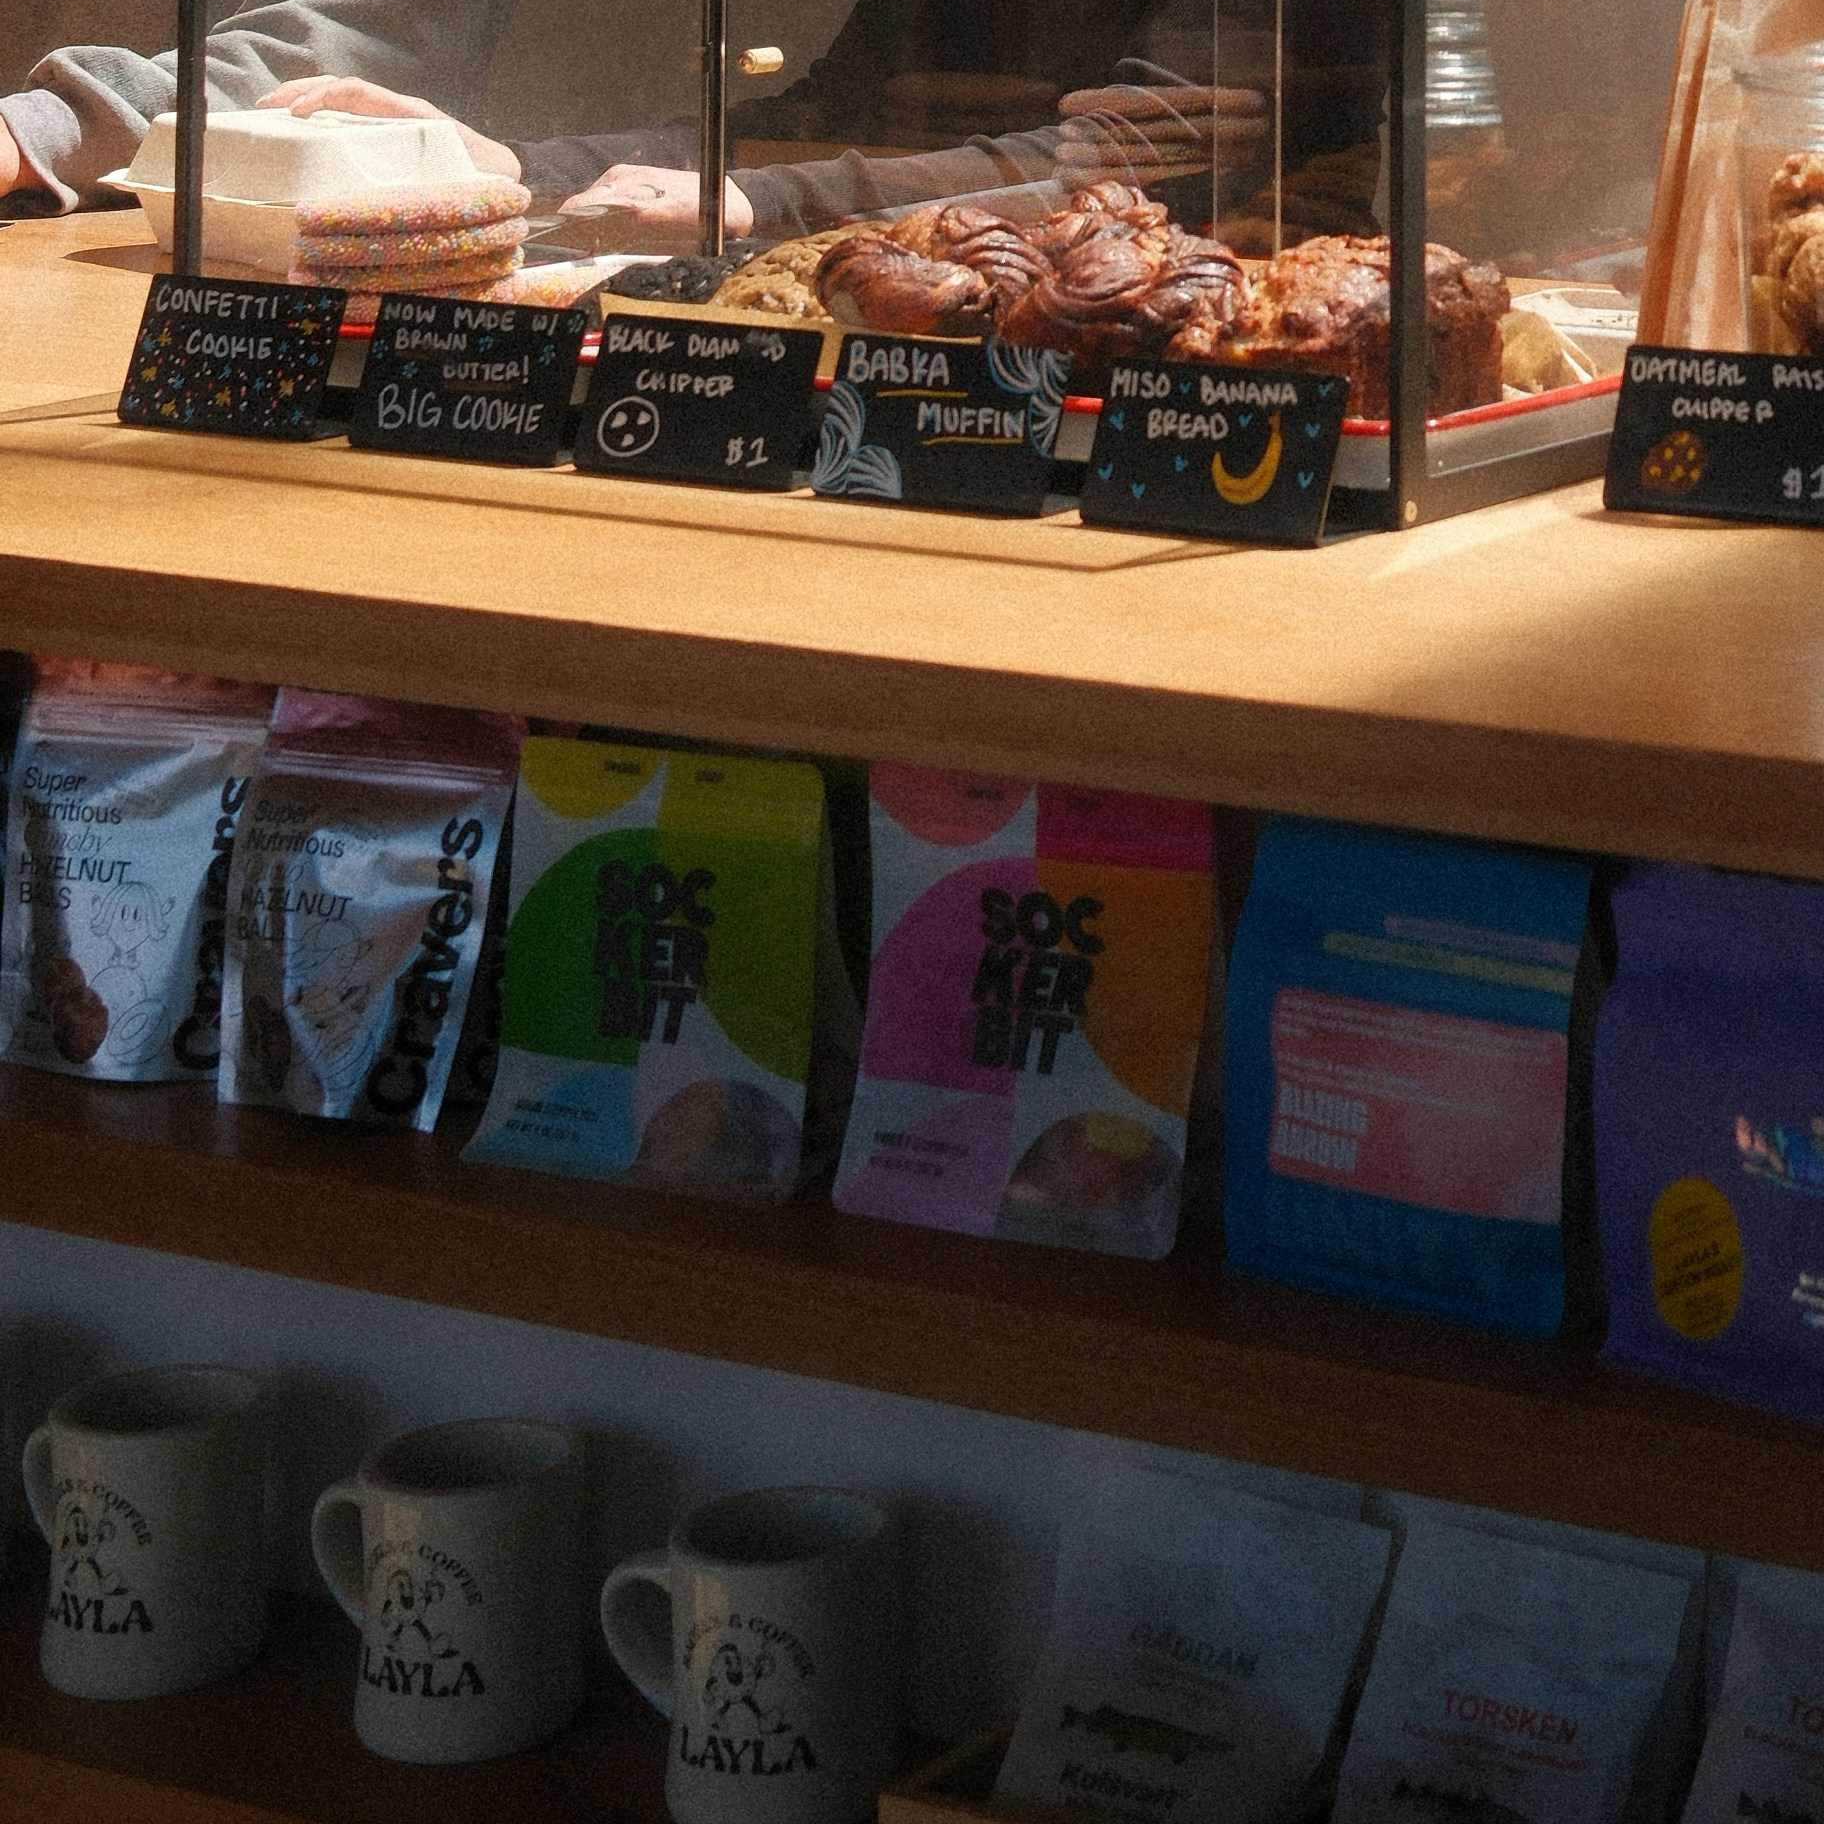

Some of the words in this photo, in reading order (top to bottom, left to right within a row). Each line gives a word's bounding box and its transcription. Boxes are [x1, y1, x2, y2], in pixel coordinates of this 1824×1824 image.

[156, 287, 279, 319] CONFETTI
[384, 302, 436, 324] NOW
[454, 306, 516, 332] MADE
[186, 330, 272, 360] COOKIE
[608, 324, 675, 354] BLACK
[848, 341, 951, 386] BABKA
[1629, 355, 1746, 387] OATMEAL
[635, 369, 735, 398] CHIPPER
[1111, 366, 1170, 399] MISO
[1200, 374, 1298, 407] BANANA
[378, 383, 442, 430] BIG
[453, 395, 544, 434] COOKIE
[918, 401, 1024, 438] MUFFIN
[1147, 408, 1229, 441] BREAD
[1672, 396, 1774, 424] CHIPPER
[725, 436, 769, 468] $1
[24, 766, 87, 797] Super
[978, 886, 1107, 957] SOC
[971, 945, 1096, 1018] KER
[362, 1644, 486, 1699] LAYLA
[1444, 1689, 1580, 1745] TORSKEN
[680, 1724, 818, 1775] LAYLA
